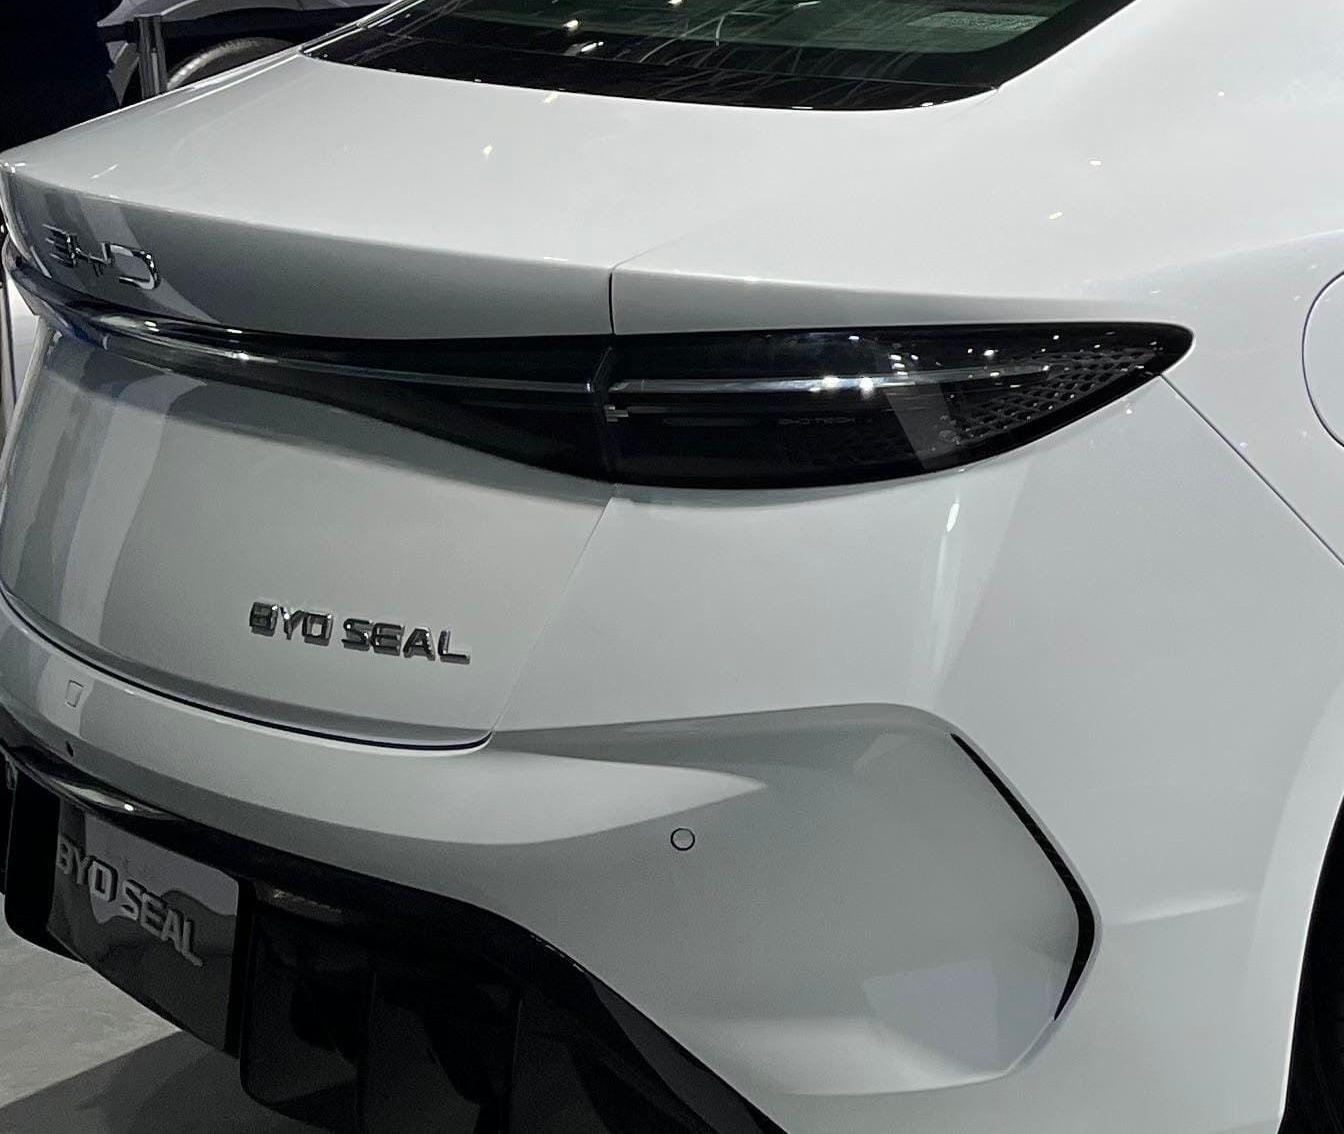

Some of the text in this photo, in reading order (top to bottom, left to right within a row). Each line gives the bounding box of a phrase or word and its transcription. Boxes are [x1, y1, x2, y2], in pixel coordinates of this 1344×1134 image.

[249, 601, 471, 664] BYD SEAL
[56, 833, 204, 967] BYD SEAL
